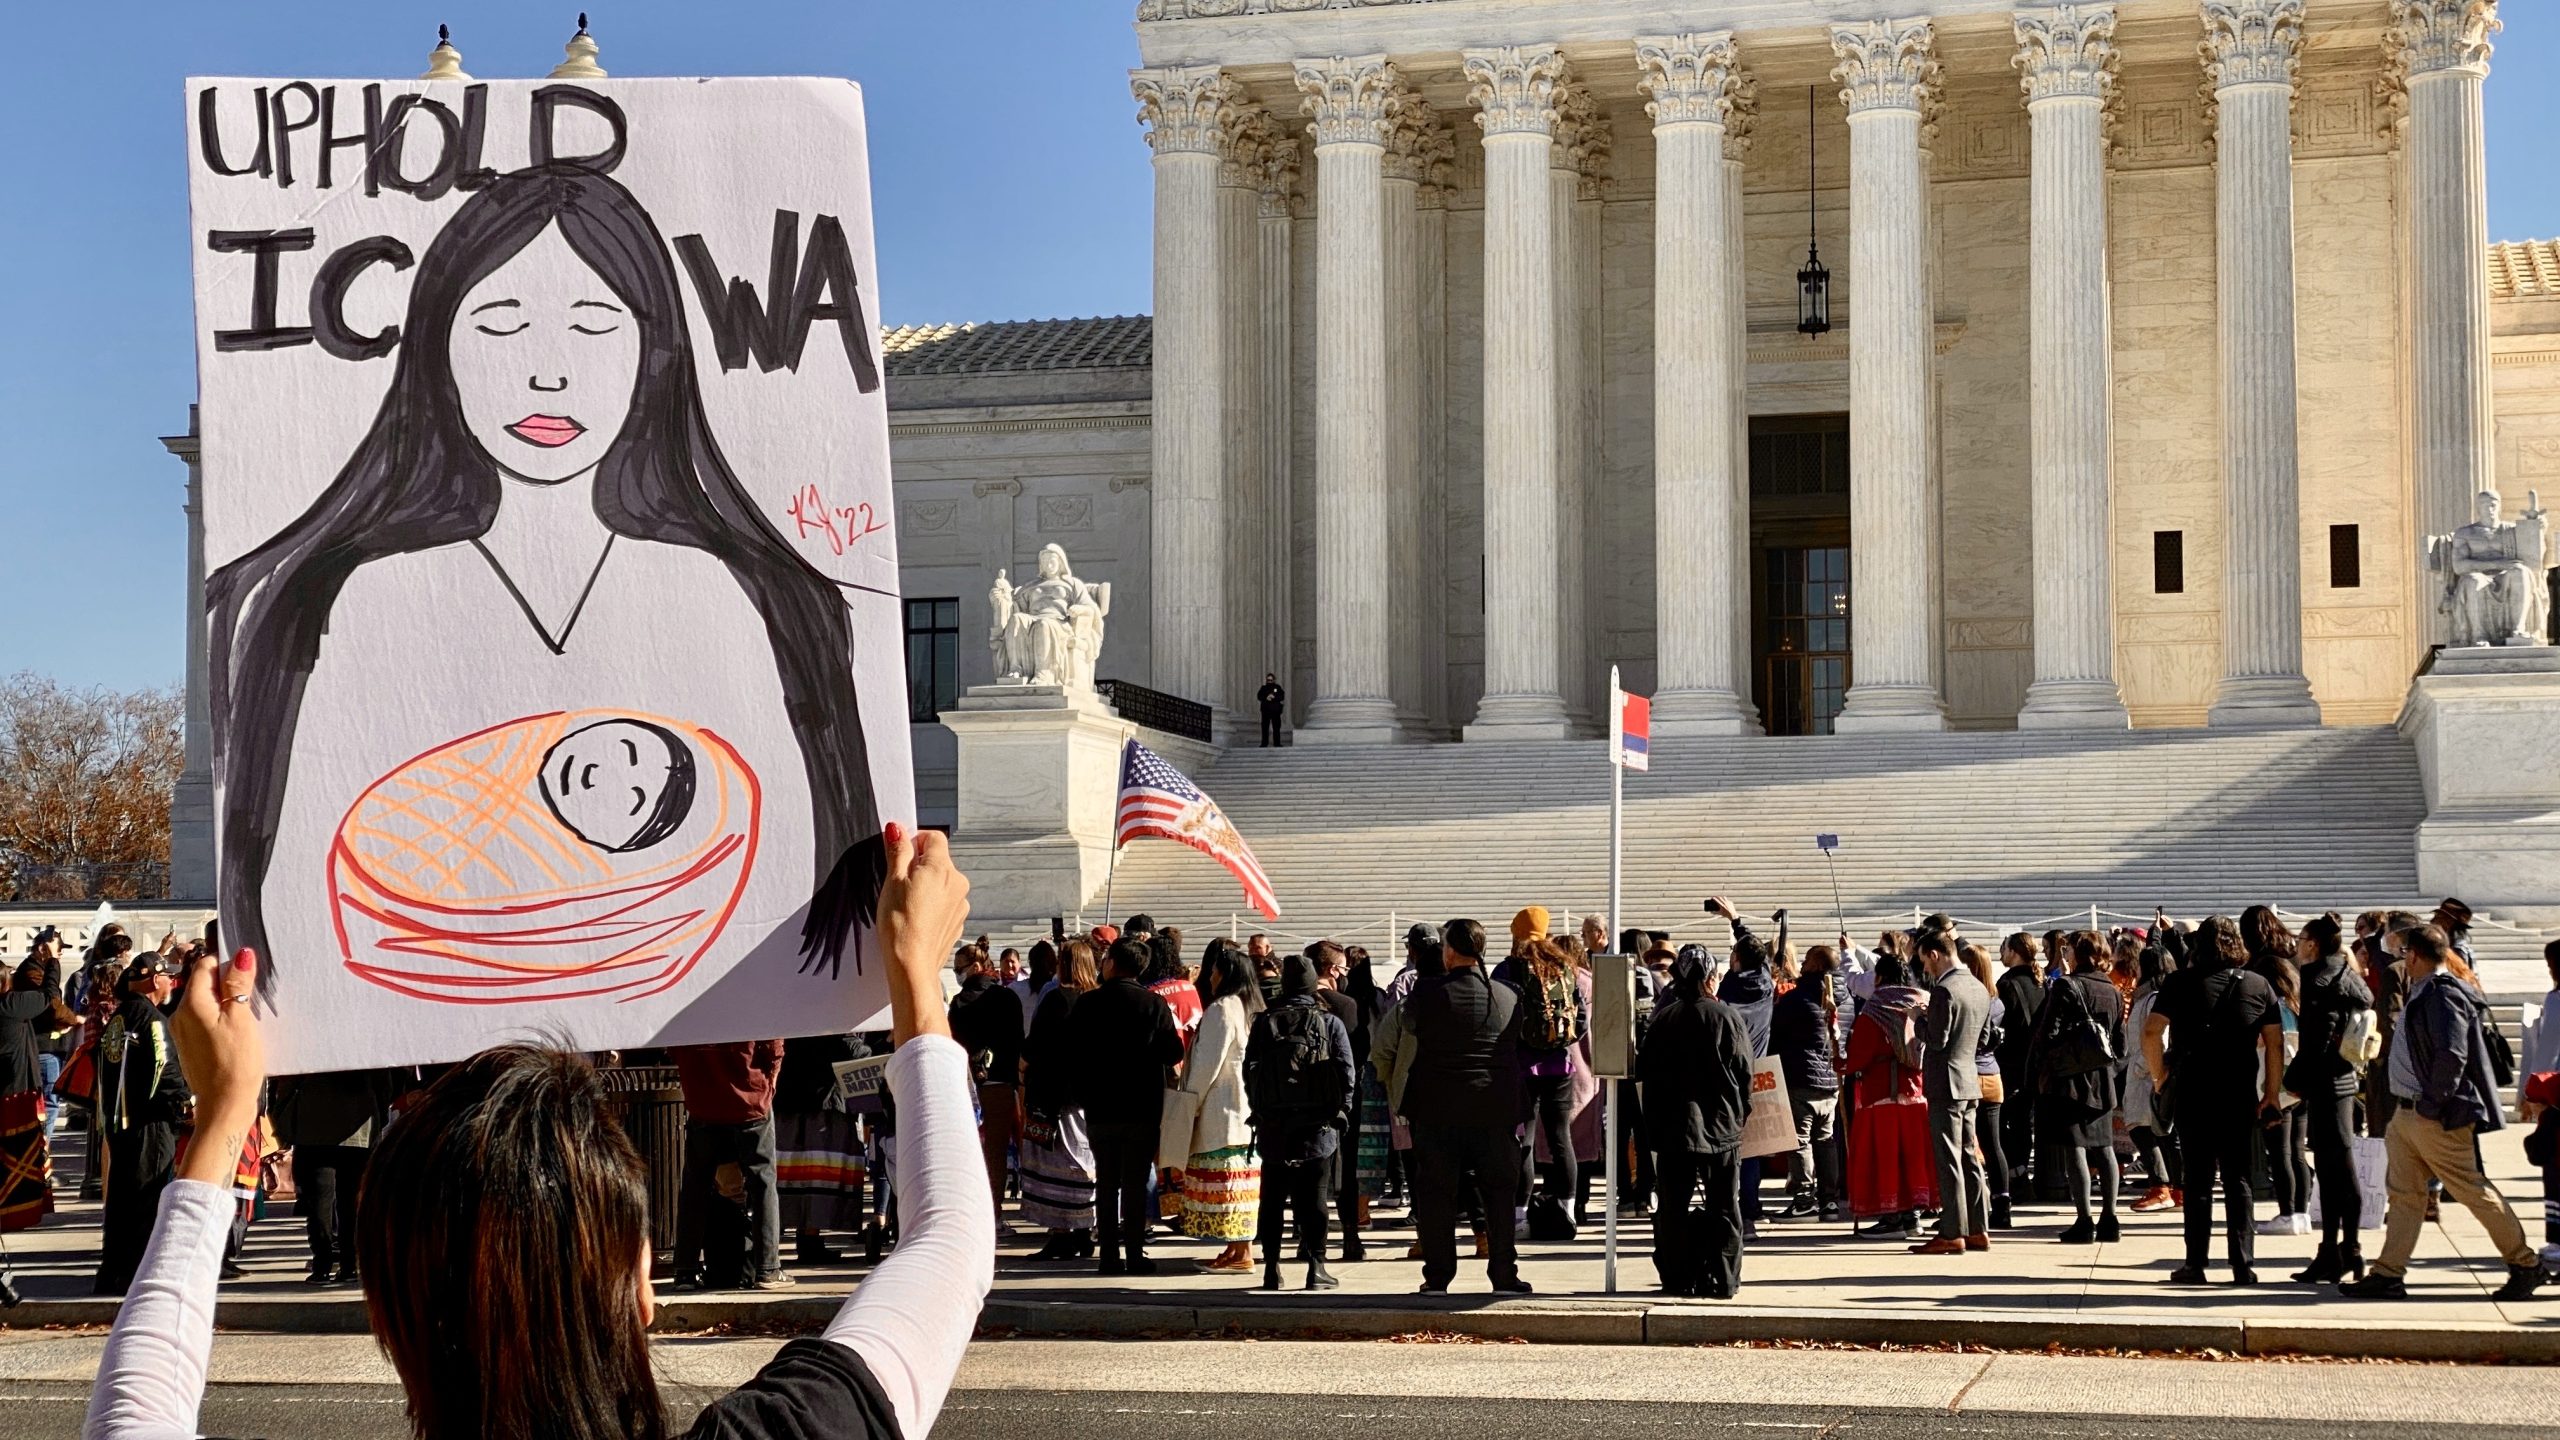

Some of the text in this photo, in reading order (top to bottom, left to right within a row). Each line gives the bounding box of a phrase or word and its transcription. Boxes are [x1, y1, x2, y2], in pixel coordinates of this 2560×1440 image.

[200, 82, 627, 198] UPHOLD
[207, 208, 881, 394] IC WA
[842, 1065, 880, 1083] STOP
